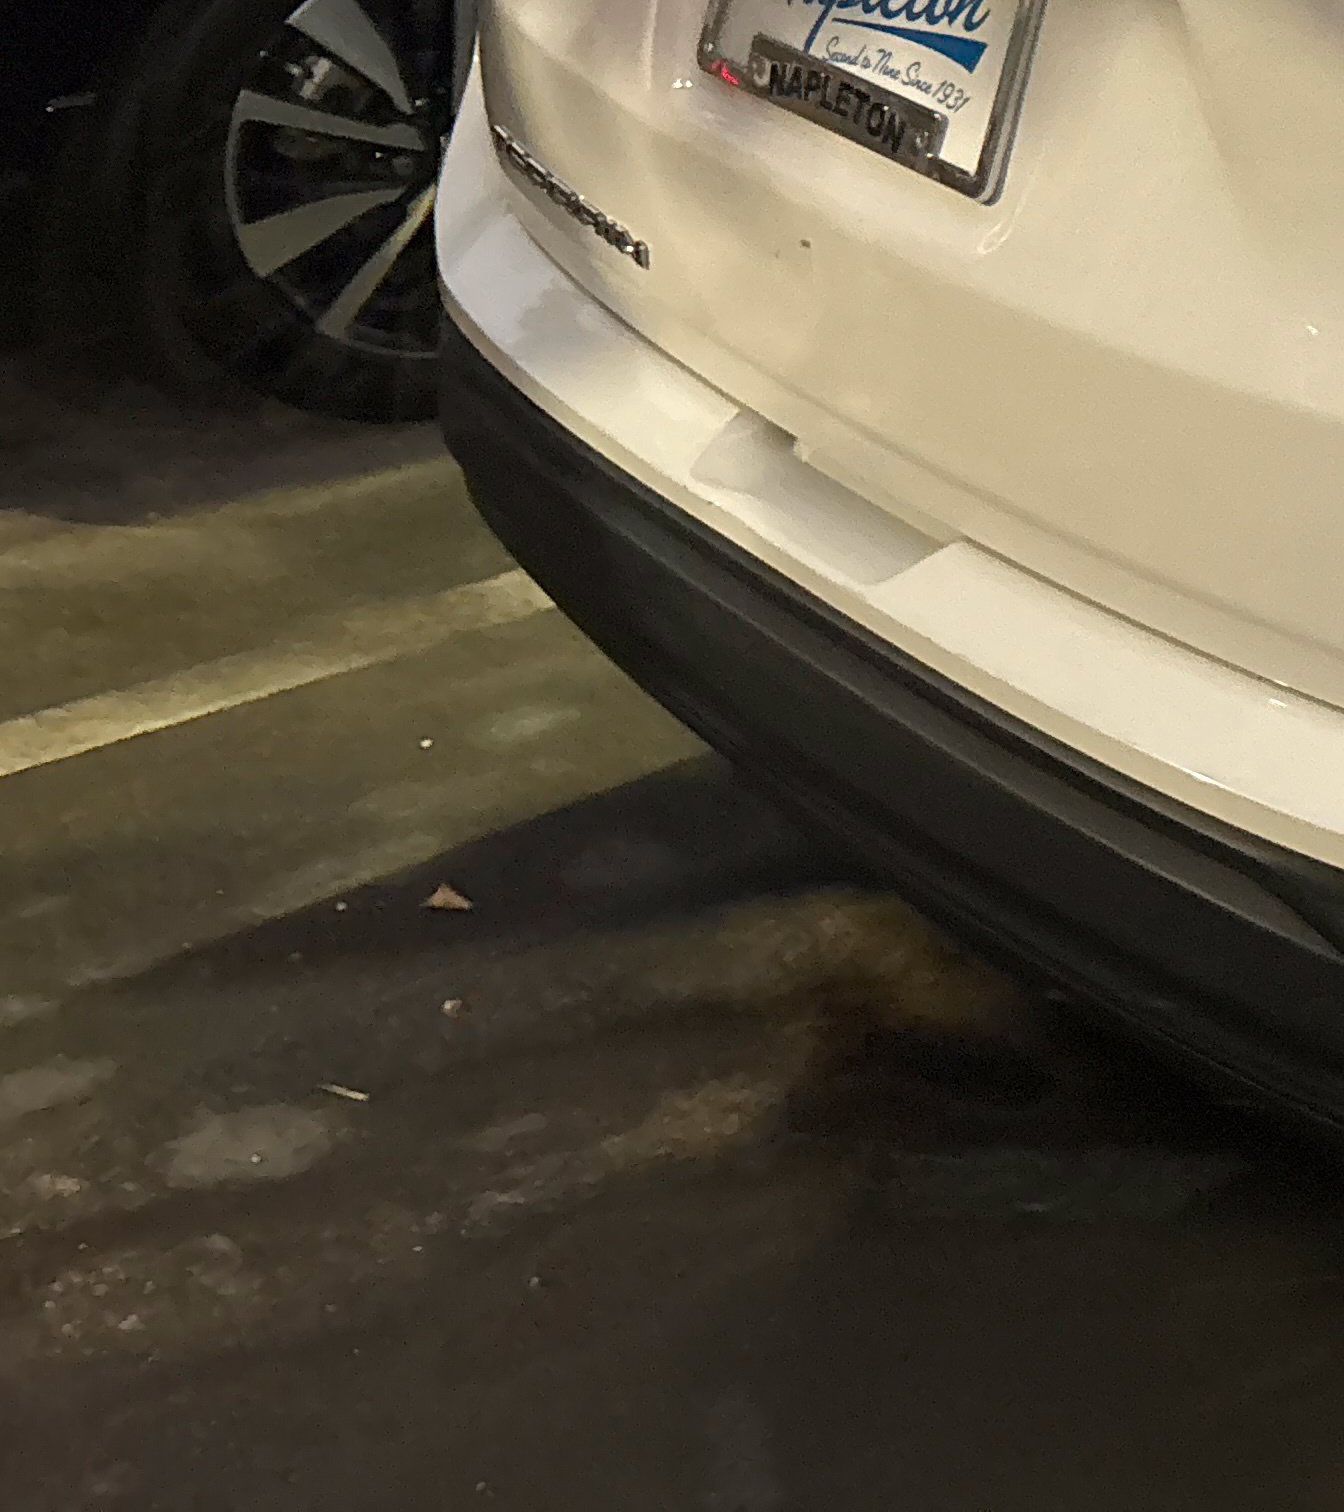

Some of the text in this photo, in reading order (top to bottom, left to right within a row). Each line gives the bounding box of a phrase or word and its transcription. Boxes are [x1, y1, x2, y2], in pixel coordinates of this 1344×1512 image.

[768, 61, 906, 154] NAPLETON
[901, 61, 934, 96] Since
[931, 80, 971, 113] 1931
